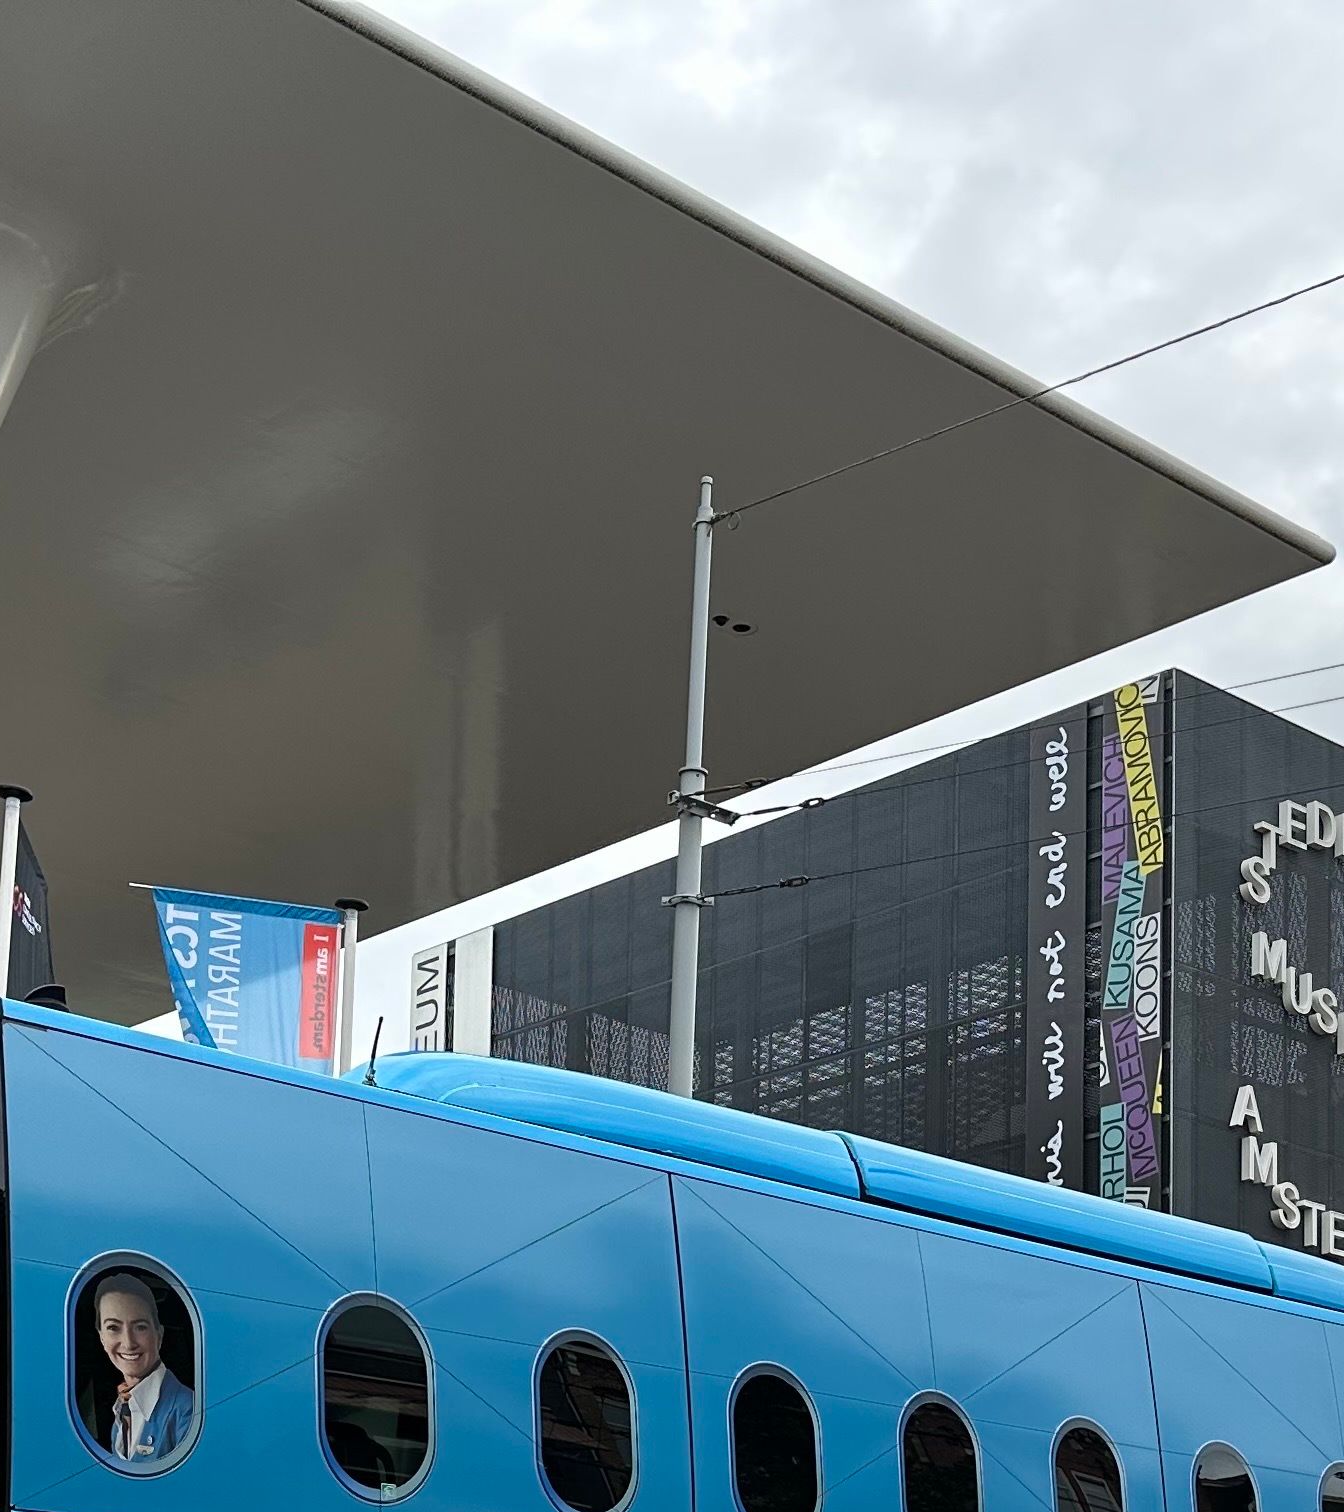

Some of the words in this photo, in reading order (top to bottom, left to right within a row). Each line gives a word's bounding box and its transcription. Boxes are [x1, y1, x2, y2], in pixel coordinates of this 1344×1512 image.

[1045, 726, 1069, 811] well
[1103, 734, 1127, 902] MALEVICH
[1039, 831, 1068, 908] end
[1040, 930, 1066, 1003] not
[1104, 865, 1144, 1008] KUSAMA
[1136, 915, 1158, 1041] KOONS
